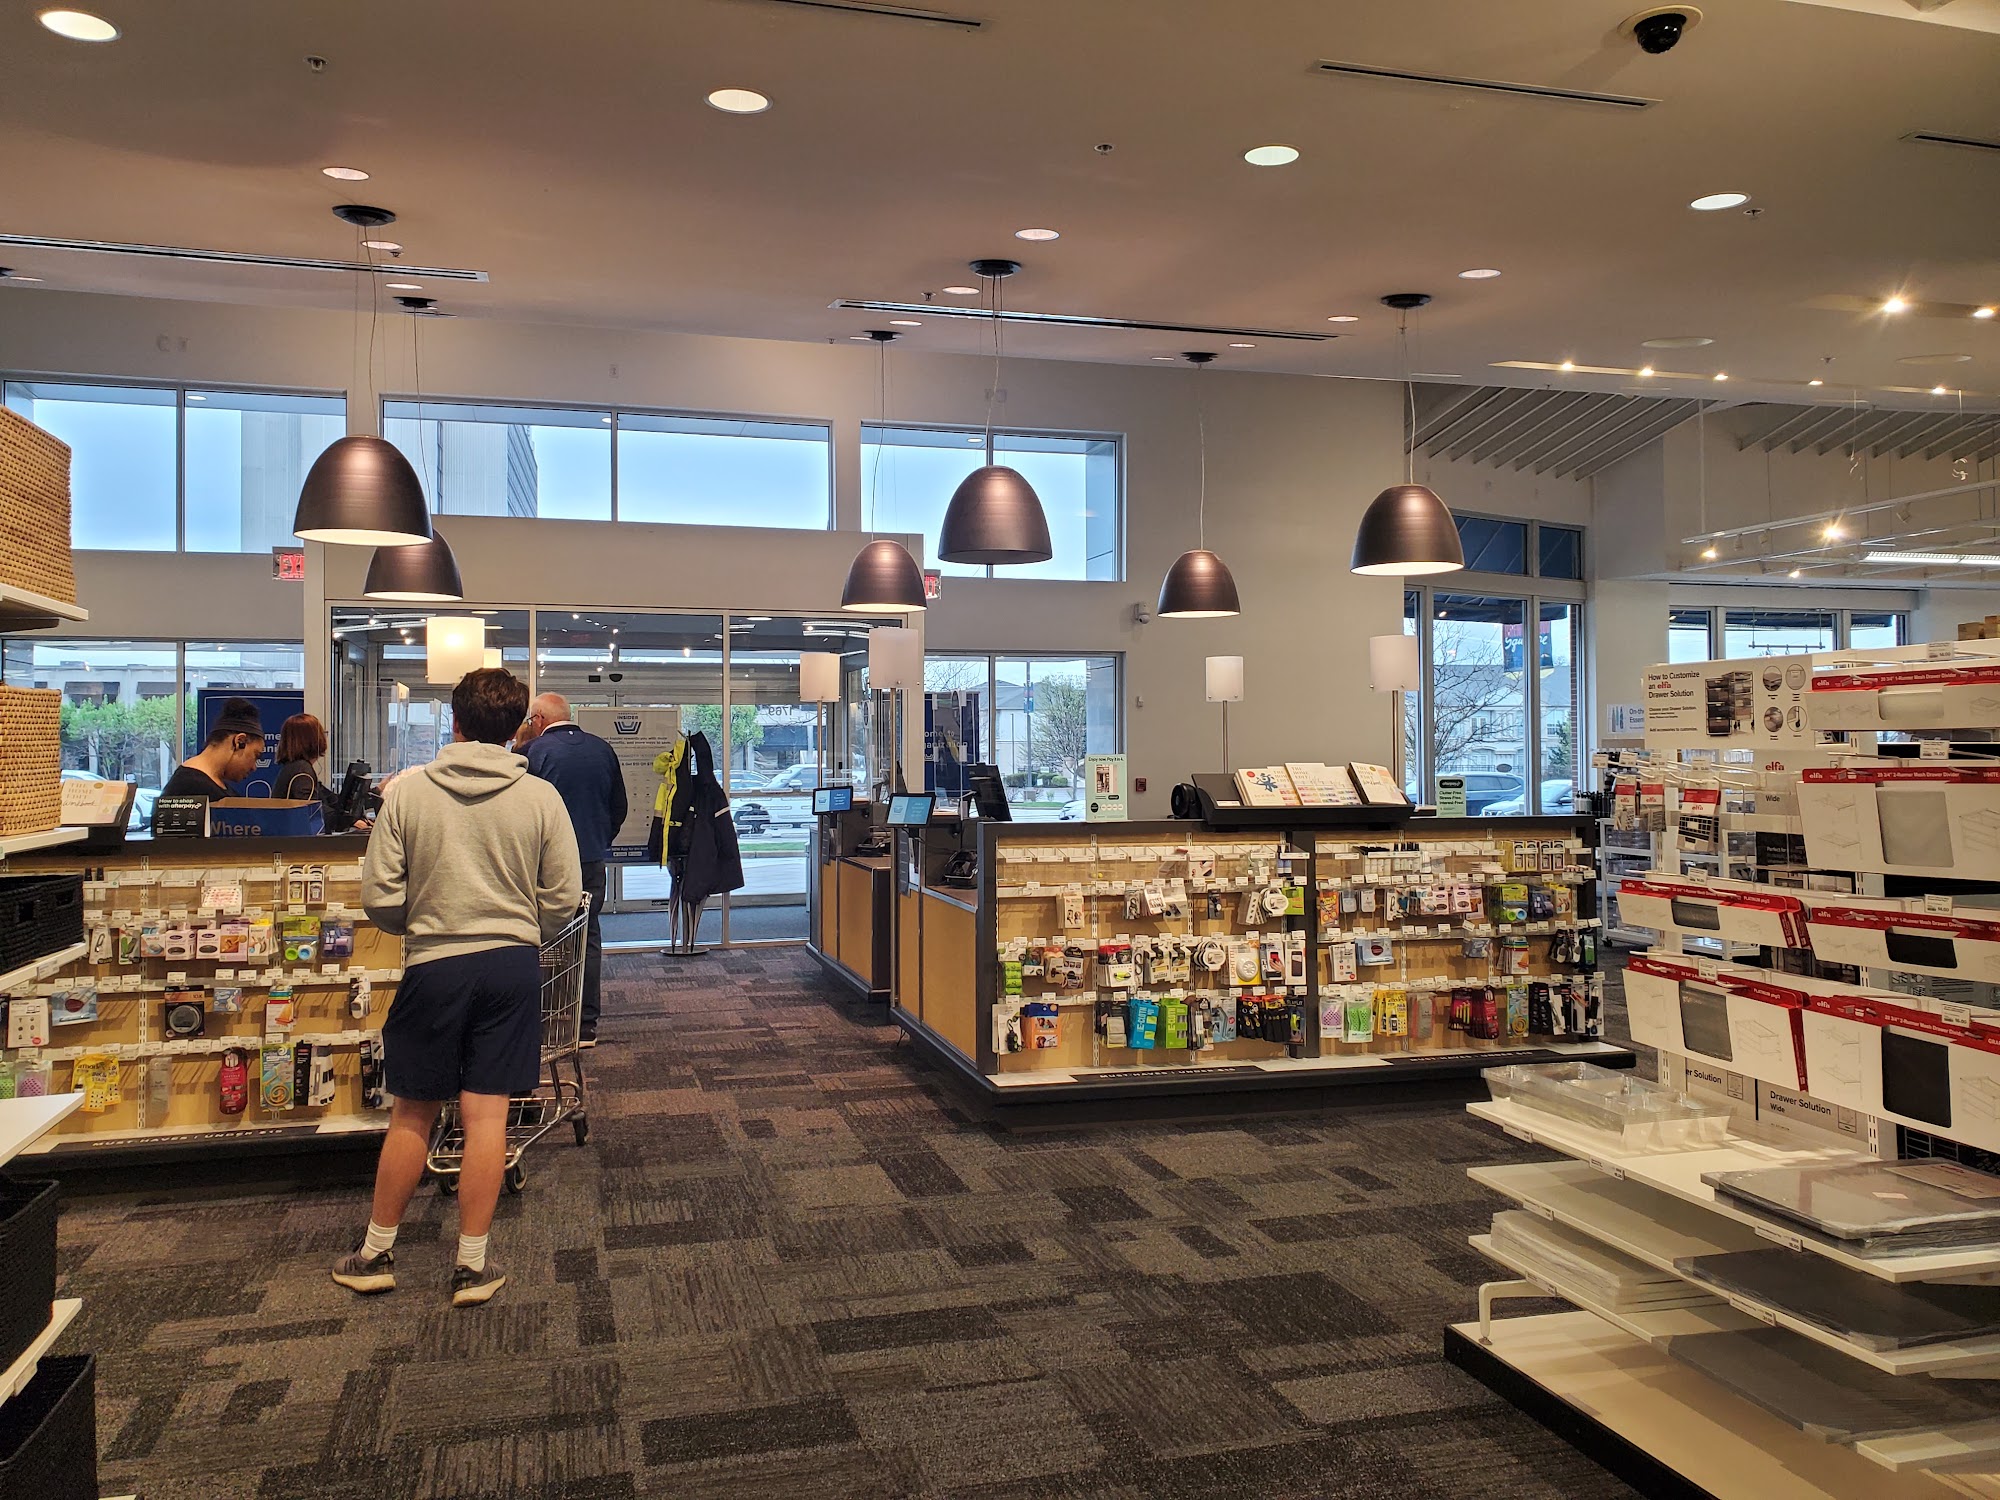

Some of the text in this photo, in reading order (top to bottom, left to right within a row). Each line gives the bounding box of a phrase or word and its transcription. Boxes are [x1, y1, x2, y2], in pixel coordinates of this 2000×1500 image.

[1648, 673, 1661, 681] How
[1669, 670, 1700, 680] Customize
[1657, 681, 1672, 689] elfa
[1648, 689, 1695, 699] Drawer Solution
[1765, 761, 1785, 771] elfa
[1765, 794, 1781, 802] Wide
[1816, 1001, 1831, 1009] elfa
[1693, 1069, 1722, 1084] Solution
[1769, 1102, 1786, 1113] Wide
[1770, 1090, 1832, 1116] Drawer Solution
[92, 1135, 188, 1148] MUST-HAVES
[204, 1130, 253, 1140] UNDER
